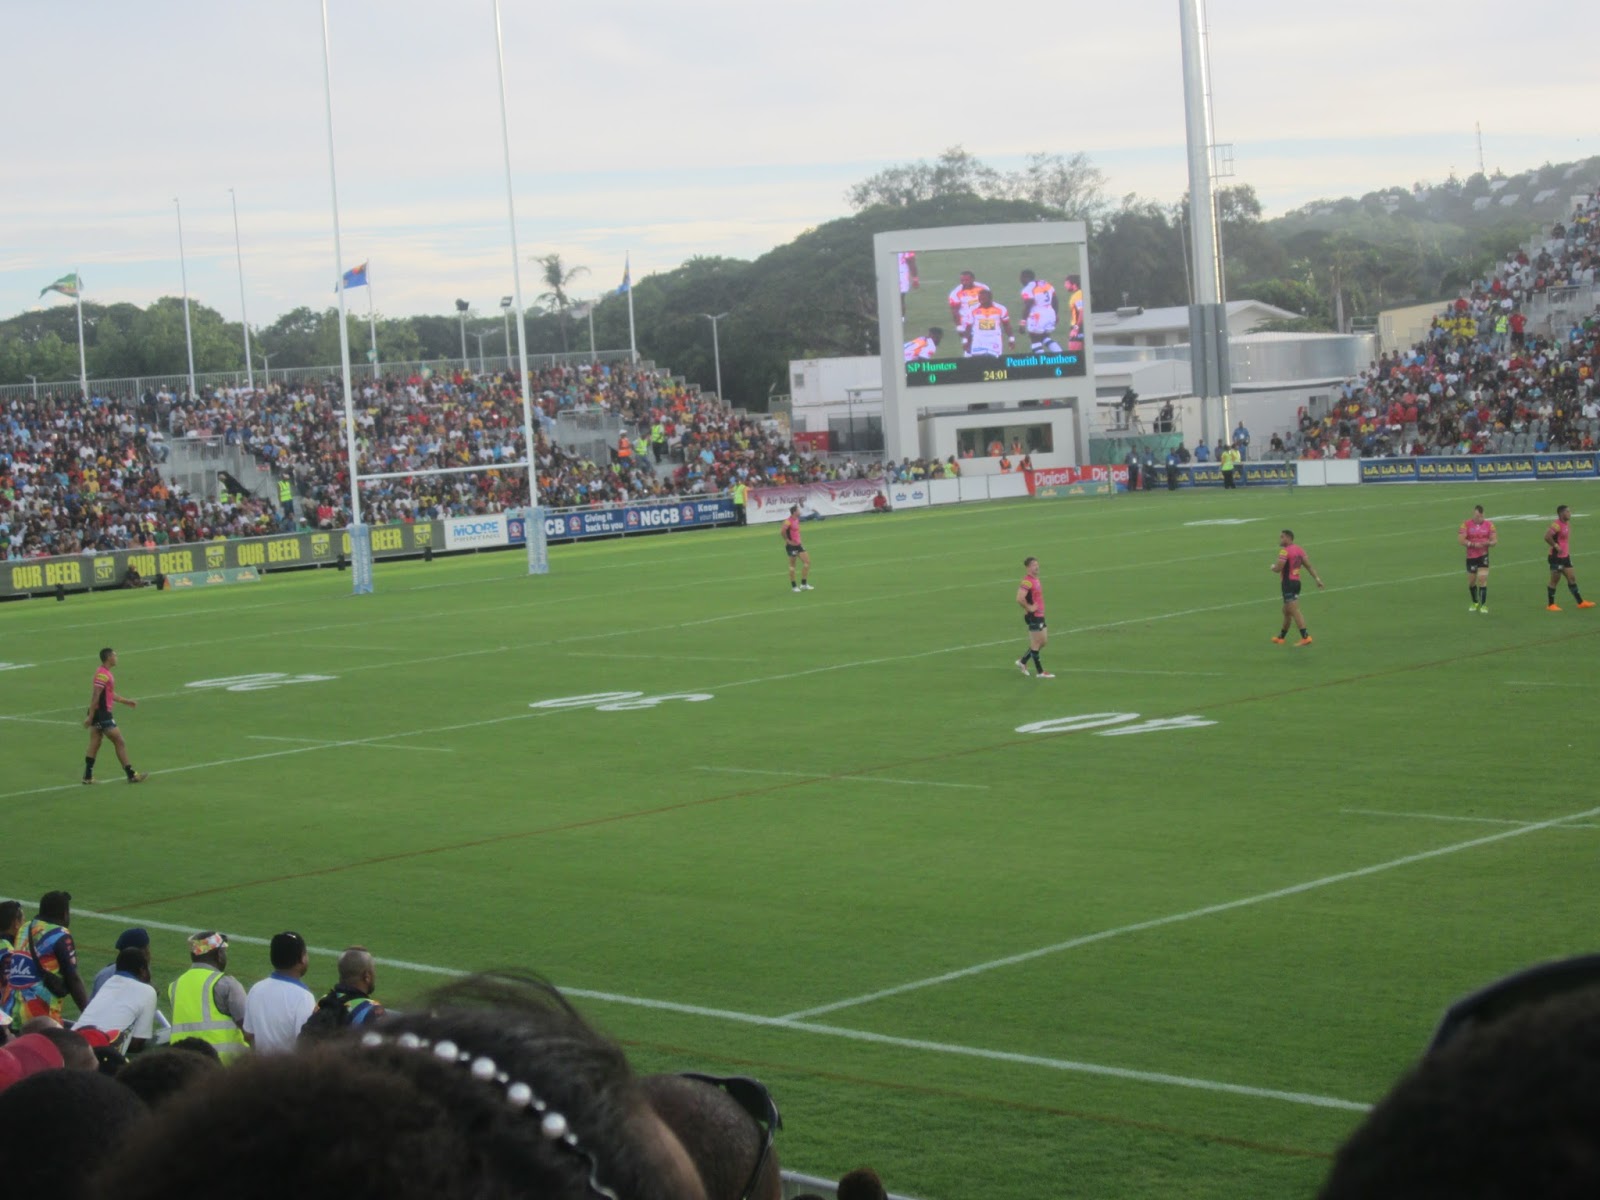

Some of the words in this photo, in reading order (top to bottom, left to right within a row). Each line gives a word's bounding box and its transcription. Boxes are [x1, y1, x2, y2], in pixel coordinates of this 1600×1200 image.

[1006, 356, 1038, 367] Penrith
[1039, 354, 1077, 366] Panthers
[908, 362, 921, 373] SP
[922, 361, 957, 372] Hunters
[1055, 367, 1062, 377] 6
[929, 374, 936, 384] 0
[983, 370, 1008, 381] 24:01
[1034, 469, 1069, 487] Digicel
[839, 490, 851, 499] Air
[853, 487, 879, 498] Niugin
[698, 503, 719, 512] Know
[766, 497, 777, 506] Air
[585, 513, 606, 523] Giving
[640, 508, 680, 526] NGCB
[712, 510, 734, 520] limits
[453, 521, 498, 537] MOORE
[585, 523, 601, 532] back
[602, 523, 610, 531] to
[610, 522, 624, 531] you
[371, 528, 403, 551] BEER
[415, 533, 430, 547] SP
[237, 543, 265, 566] OUR
[268, 538, 300, 562] BEER
[313, 544, 328, 558] SP
[159, 550, 193, 575] BEER
[208, 555, 224, 569] SP
[12, 566, 43, 590] OUR
[45, 561, 81, 586] BEER
[96, 566, 113, 579] SP
